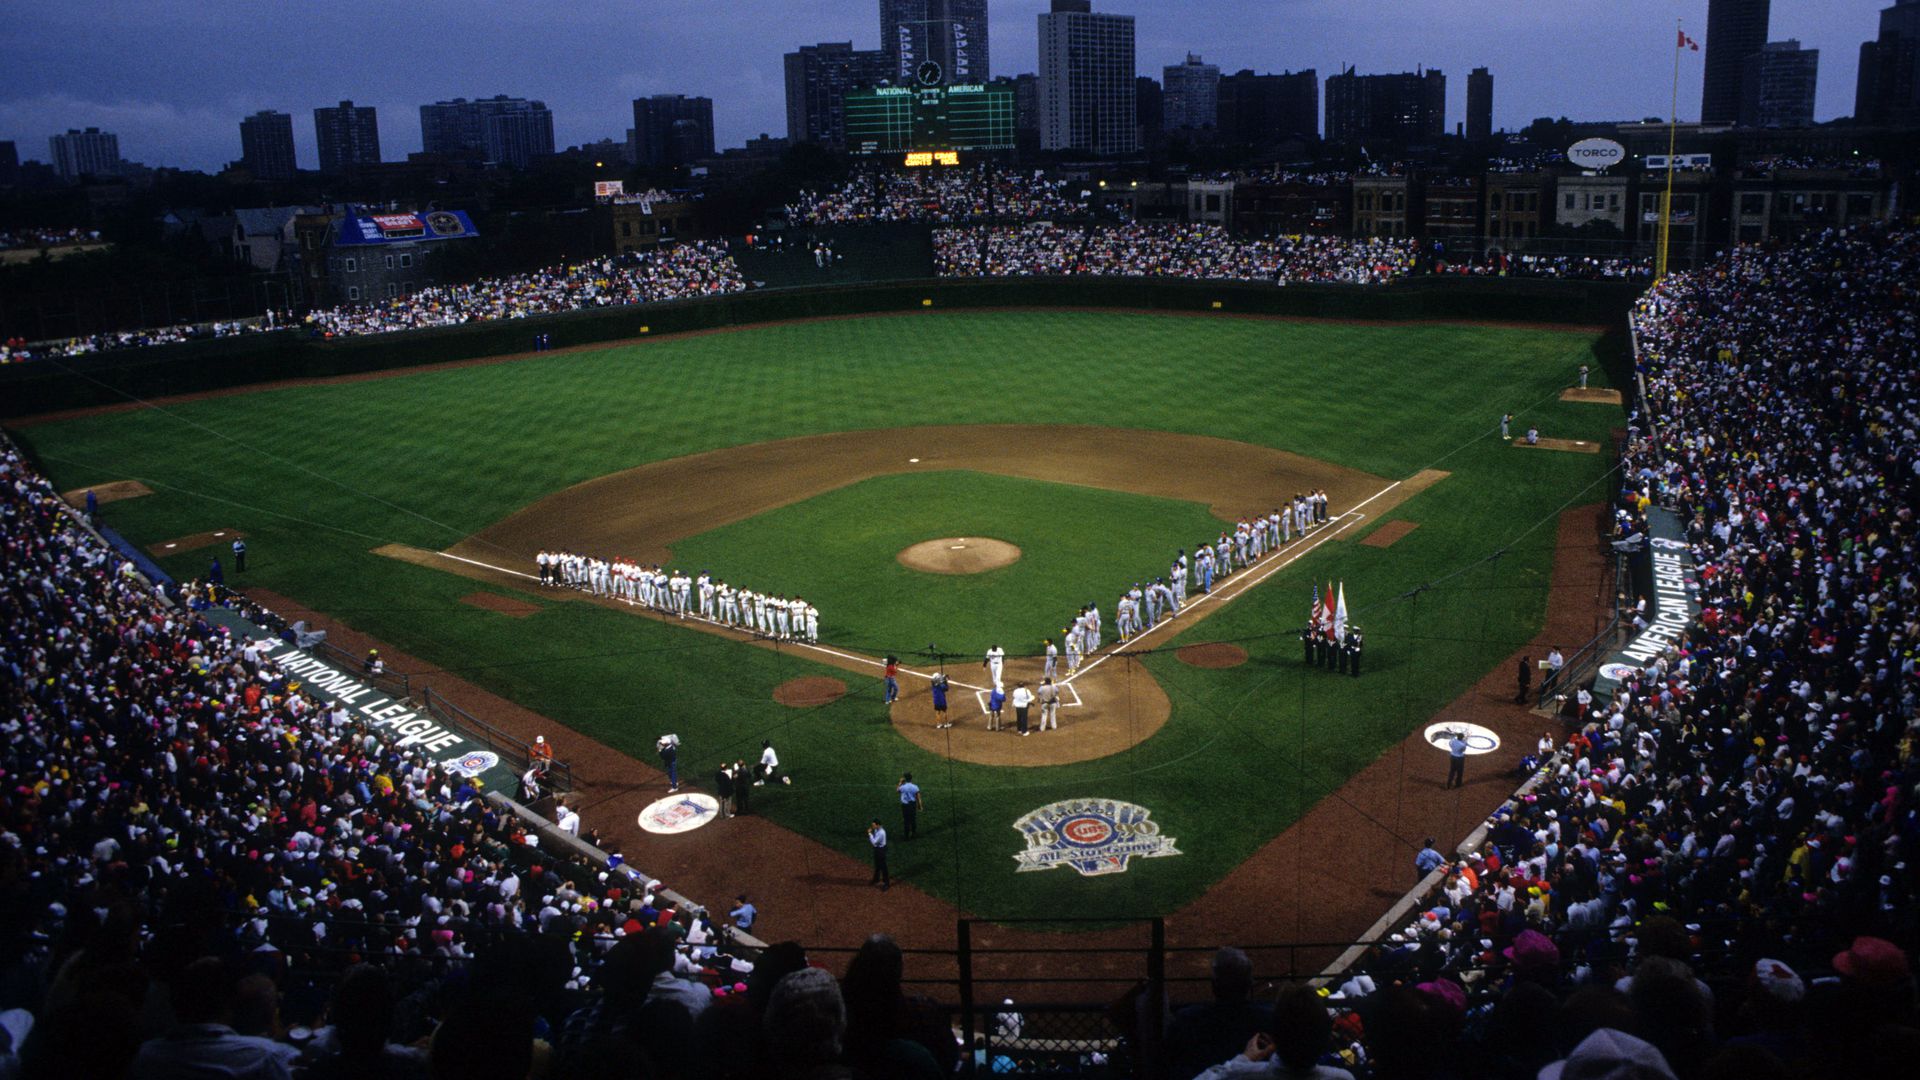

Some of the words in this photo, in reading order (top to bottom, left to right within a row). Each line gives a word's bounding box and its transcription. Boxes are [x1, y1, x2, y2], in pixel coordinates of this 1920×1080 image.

[876, 88, 913, 96] NATIONAL
[948, 85, 985, 93] AMERICAN
[1574, 148, 1618, 157] TORCO
[1654, 552, 1686, 596] LEAGUE
[1622, 597, 1690, 662] AMERICAN
[272, 650, 372, 704] NATIONAL
[358, 698, 464, 753] LEAGUE
[1049, 807, 1115, 822] CHICAGO
